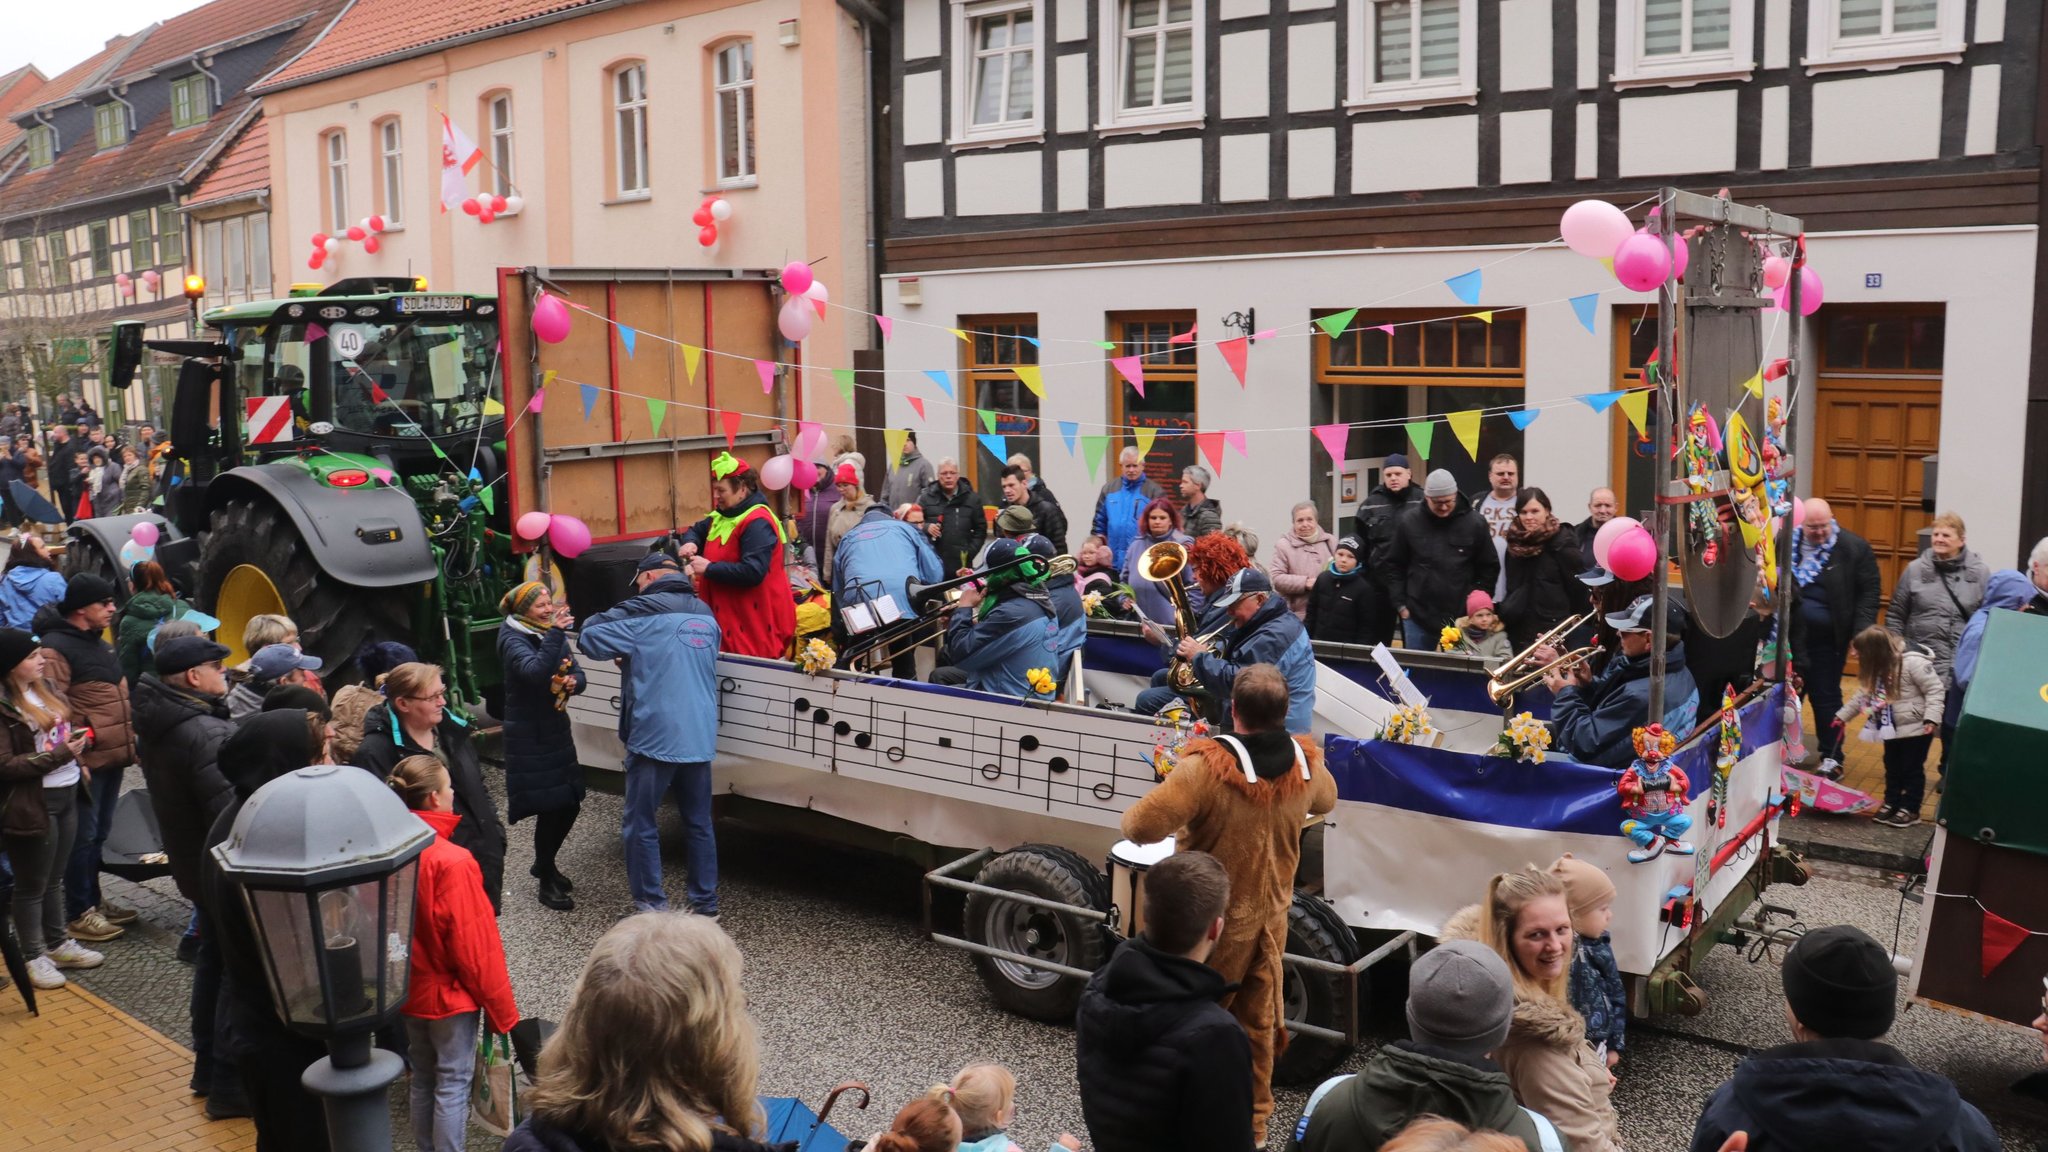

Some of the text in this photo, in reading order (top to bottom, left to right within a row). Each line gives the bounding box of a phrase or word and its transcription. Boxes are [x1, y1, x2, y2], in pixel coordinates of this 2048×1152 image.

[1867, 275, 1880, 286] 33
[404, 297, 422, 310] SDL
[444, 297, 461, 309] 309
[341, 332, 358, 350] 40
